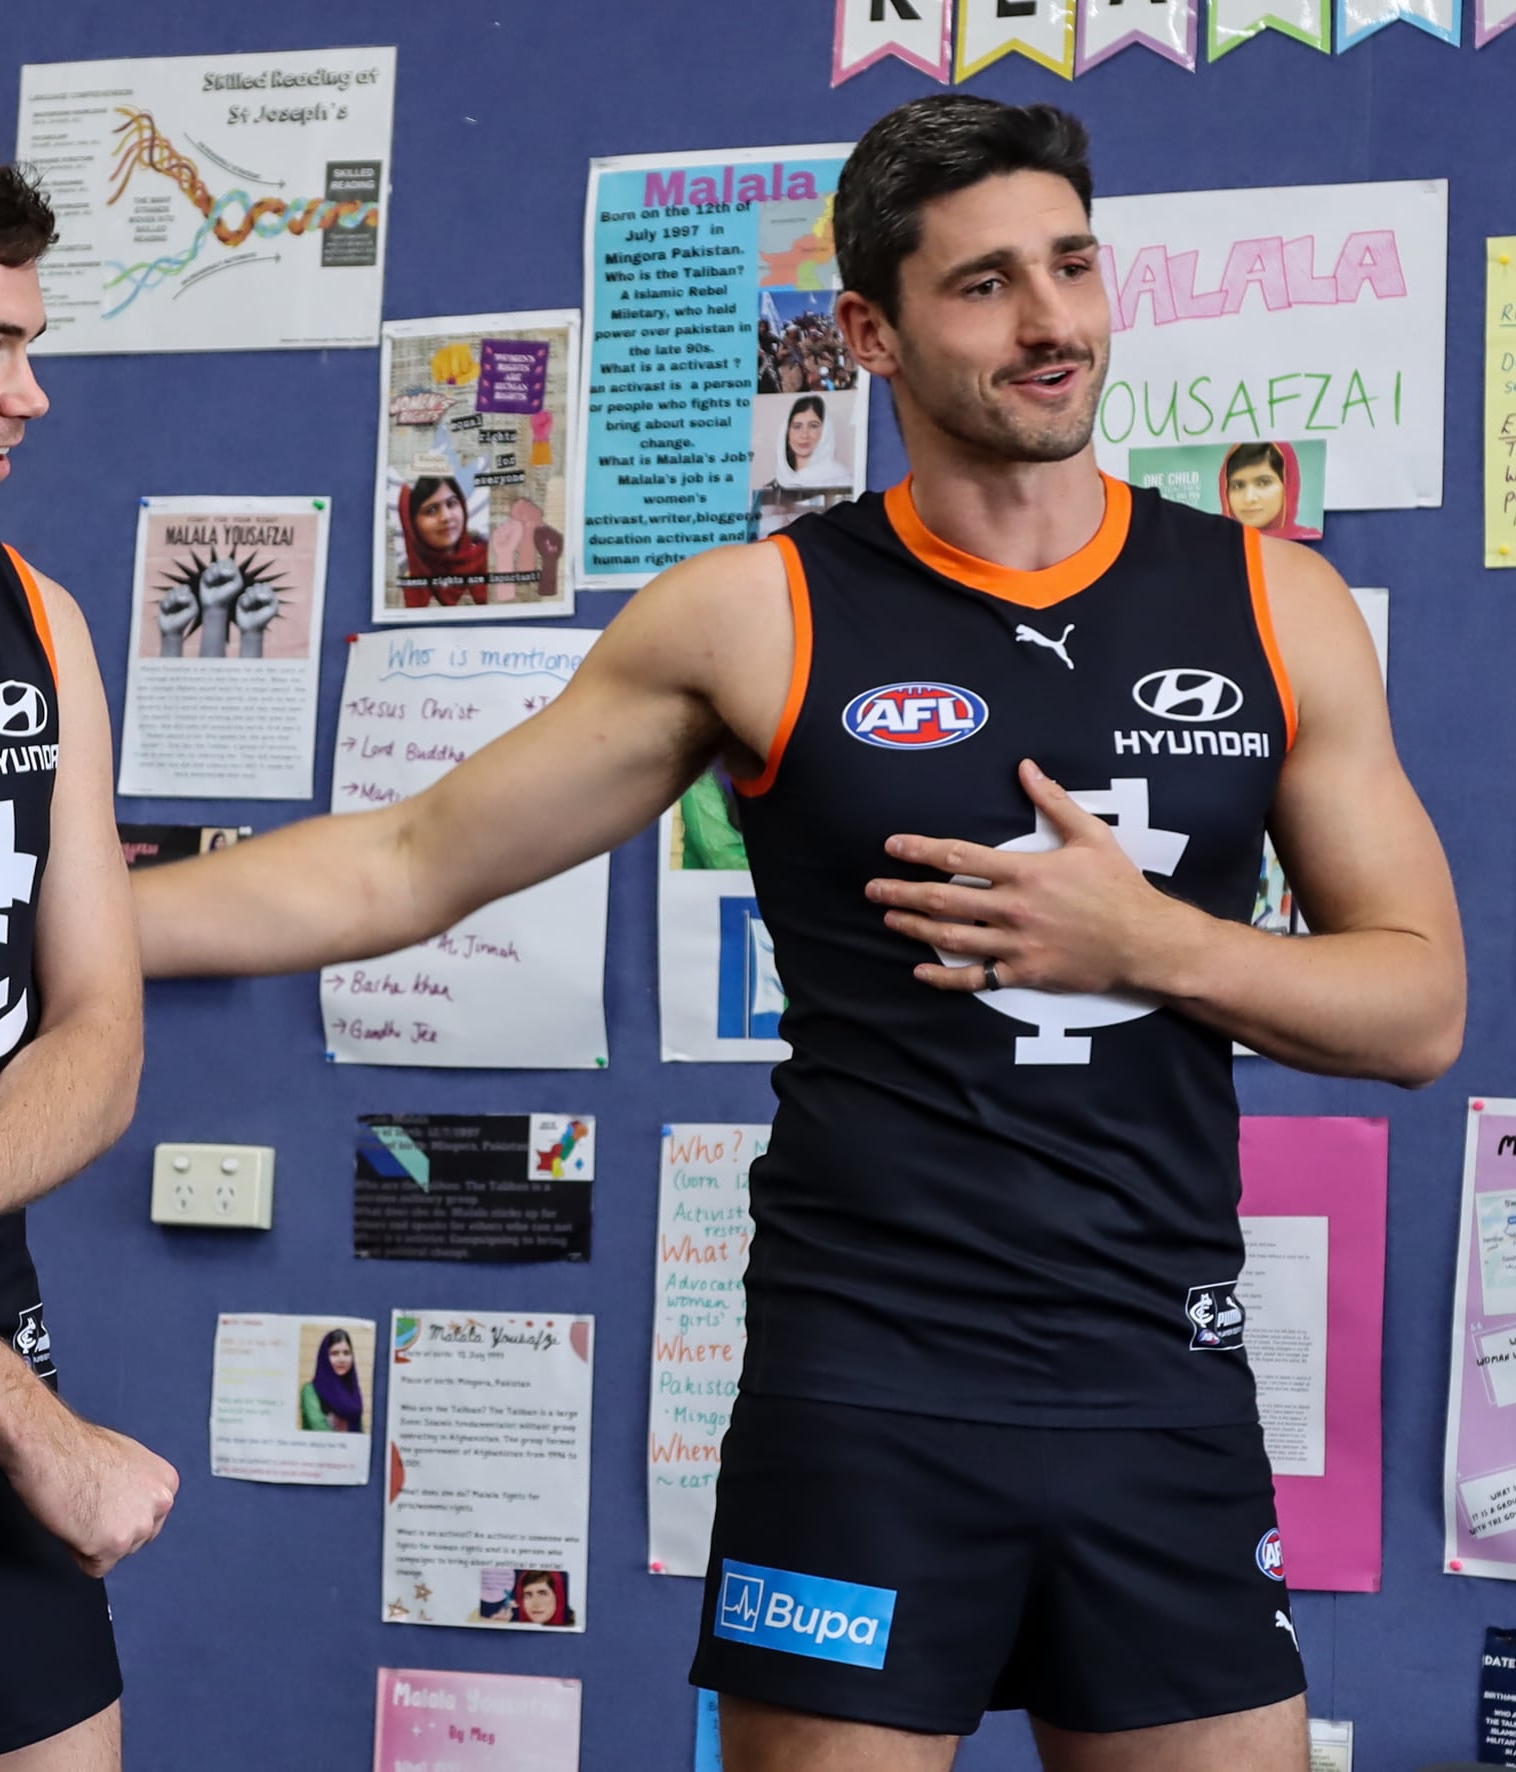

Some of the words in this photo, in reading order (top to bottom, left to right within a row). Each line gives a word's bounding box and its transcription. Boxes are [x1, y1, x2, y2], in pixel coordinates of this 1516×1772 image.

[202, 70, 269, 92] Skilled
[271, 68, 349, 90] Reading
[227, 106, 249, 125] St
[644, 164, 818, 207] Malala
[601, 211, 635, 222] Born
[641, 209, 659, 219] on
[665, 205, 690, 217] the
[697, 202, 730, 215] 12th
[736, 200, 751, 211] of
[626, 228, 656, 242] July
[663, 225, 698, 238] 1997
[710, 224, 724, 234] in
[605, 252, 667, 265] Mingora
[672, 245, 744, 258] Pakistan.
[606, 270, 634, 282] Who
[640, 269, 651, 280] is
[656, 267, 678, 279] the
[683, 265, 744, 278] Taliban?
[621, 290, 629, 300] A
[635, 288, 684, 300] Islamic
[689, 285, 727, 297] Rebel
[675, 307, 703, 317] who
[707, 304, 736, 315] held
[595, 328, 635, 341] power
[641, 327, 670, 337] over
[675, 323, 734, 336] pakistan
[739, 322, 752, 333] in
[629, 345, 651, 356] the
[655, 344, 681, 355] late
[686, 342, 715, 354] 90s.
[601, 363, 635, 374] What
[641, 362, 652, 372] is
[657, 363, 665, 371] a
[590, 384, 605, 394] an
[670, 380, 681, 391] is
[691, 381, 699, 390] a
[703, 379, 752, 392] person
[590, 403, 602, 413] or
[607, 401, 653, 414] people
[658, 399, 686, 409] who
[691, 396, 731, 411] fights
[736, 397, 749, 407] to
[1100, 370, 1401, 443] OUSAFZAI
[606, 420, 641, 432] bring
[645, 418, 684, 429] about
[689, 416, 731, 428] social
[640, 437, 695, 450] change.
[599, 454, 634, 466] What
[639, 453, 651, 465] is
[657, 451, 715, 464] Malala's
[721, 450, 754, 463] Job?
[618, 473, 676, 485] Malala's
[681, 472, 704, 486] job
[709, 471, 720, 483] is
[726, 473, 734, 482] a
[1144, 474, 1164, 487] ONE
[1168, 471, 1199, 485] CHILD
[643, 492, 707, 504] women's
[165, 526, 218, 545] MALALA
[224, 526, 294, 546] YOUSAFZAI
[719, 529, 745, 542] and
[593, 553, 640, 565] human
[388, 638, 433, 668] Who
[450, 649, 467, 667] is
[857, 697, 975, 733] AFL
[1114, 730, 1270, 758] HYUNDAI
[673, 1202, 746, 1223] Activist
[667, 1295, 730, 1310] women
[656, 1332, 734, 1363] Where
[764, 1592, 879, 1645] Bupa
